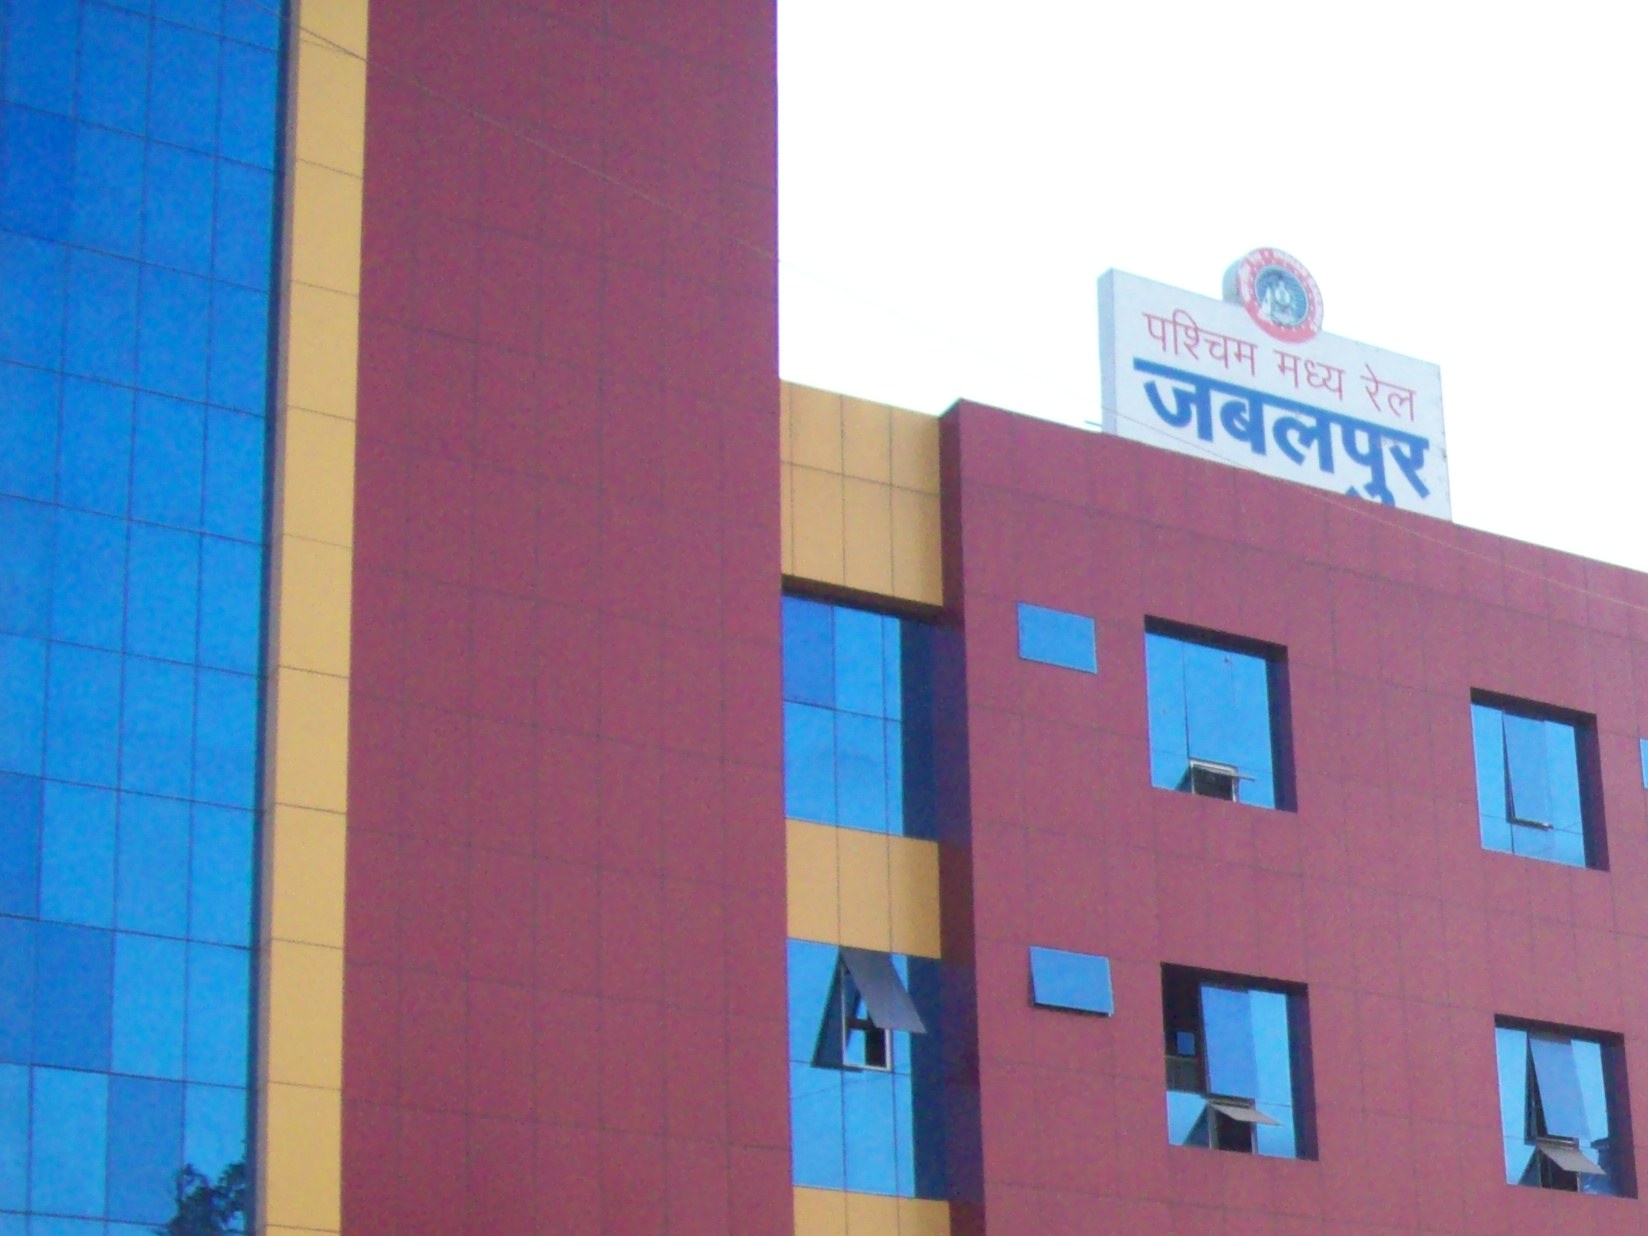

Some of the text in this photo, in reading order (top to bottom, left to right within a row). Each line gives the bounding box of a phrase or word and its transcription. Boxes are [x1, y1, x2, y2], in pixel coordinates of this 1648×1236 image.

[1142, 308, 1417, 422] पश्चिम मध्य रेल
[1133, 356, 1431, 509] जबलपुर
